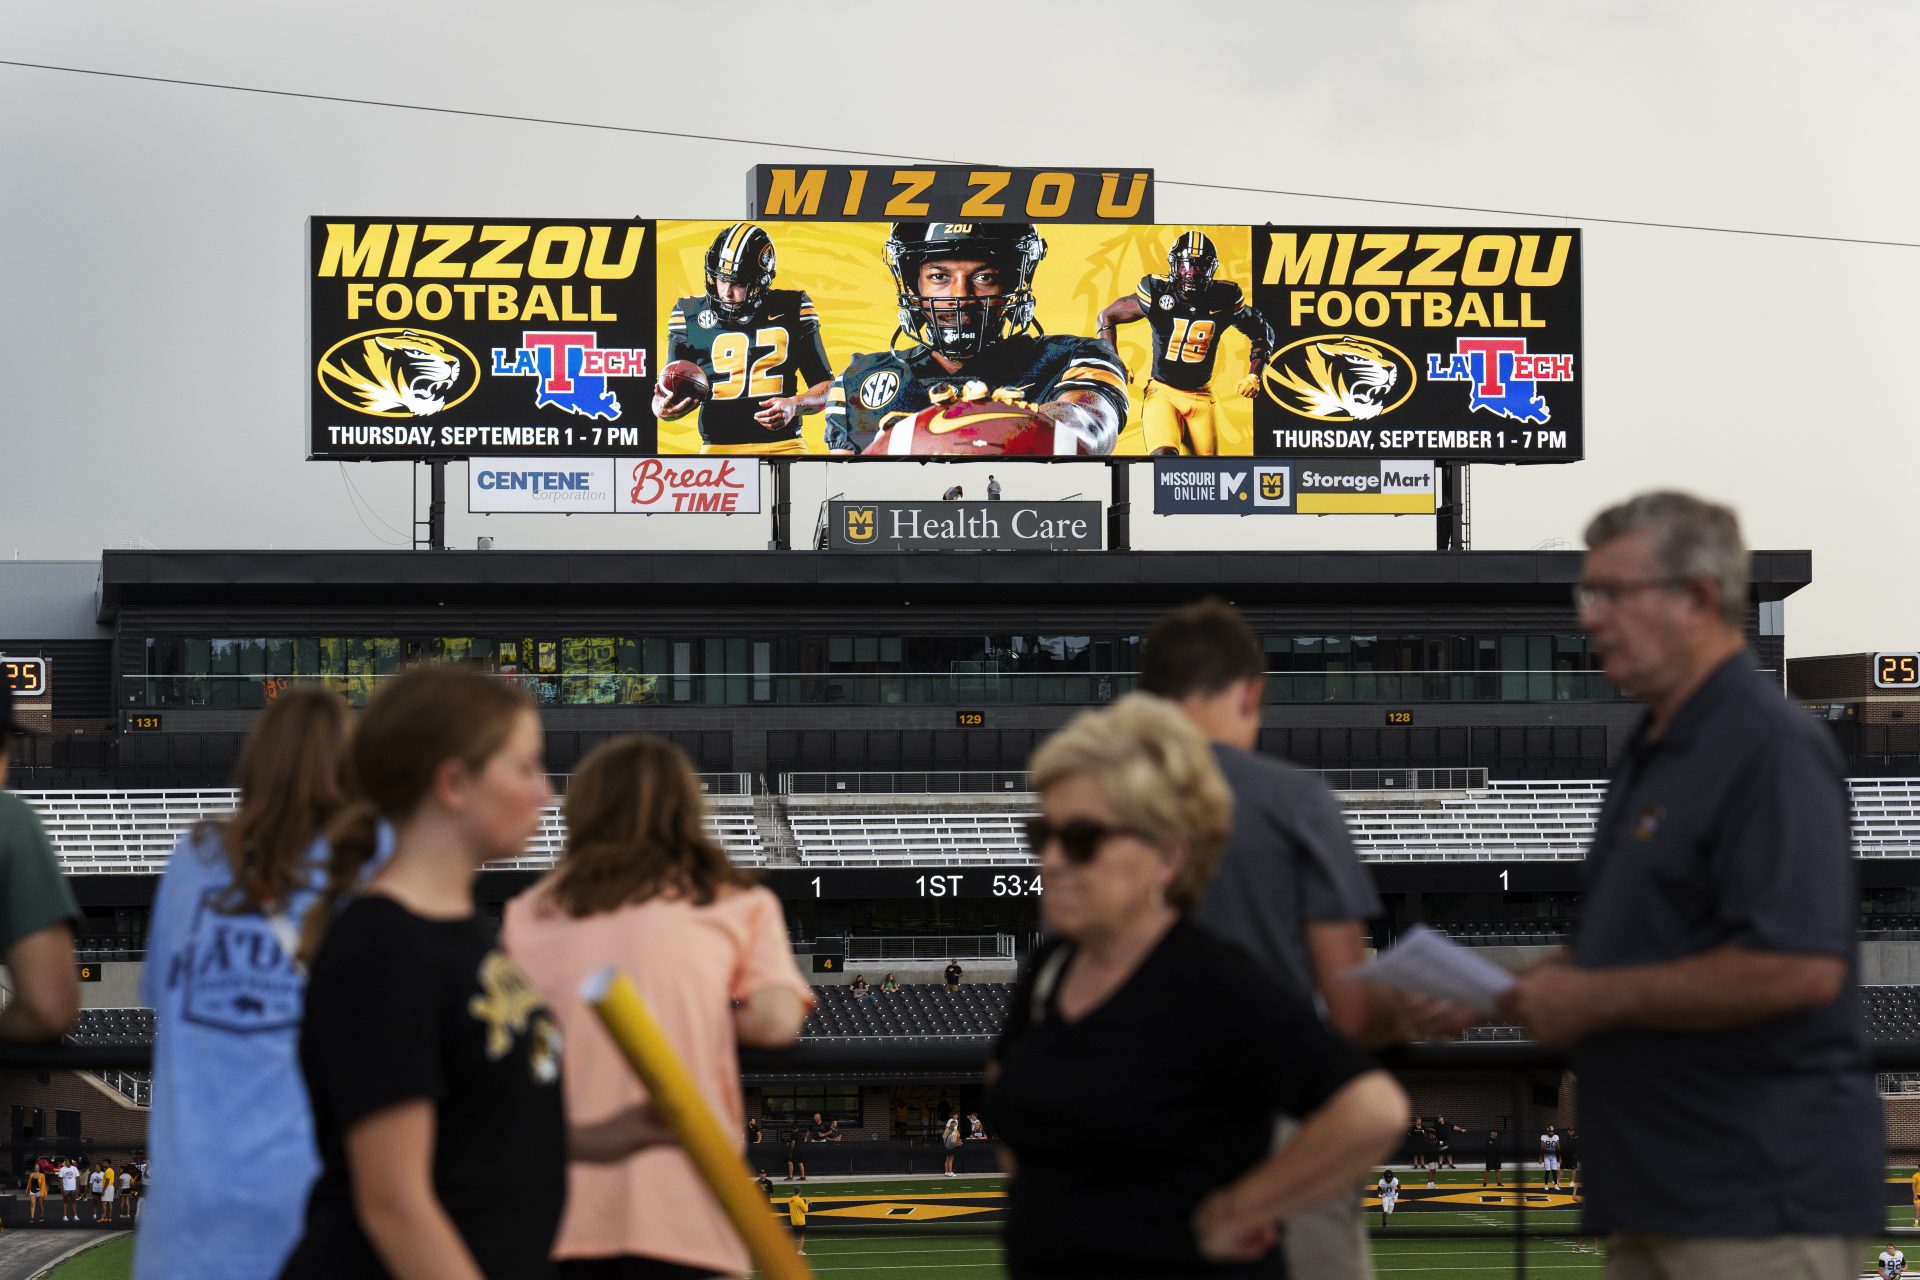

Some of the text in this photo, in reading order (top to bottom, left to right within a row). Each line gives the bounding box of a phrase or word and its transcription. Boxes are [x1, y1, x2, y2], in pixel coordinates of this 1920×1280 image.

[764, 168, 1149, 218] MIZZOU
[944, 223, 973, 234] ZOU
[318, 223, 646, 280] MIZZOU
[1262, 233, 1573, 287] MIZZOU
[347, 283, 617, 321] FOOTBALL
[1290, 291, 1546, 328] FOOTBALL
[1165, 317, 1216, 363] 18
[711, 327, 789, 401] 92
[861, 372, 898, 408] SEC
[328, 426, 435, 447] THURSDAY,
[441, 426, 559, 445] SEPTEMBER
[564, 427, 573, 445] 1
[592, 427, 602, 445] 7
[607, 427, 639, 446] PM
[1272, 430, 1375, 450] THURSDAY,
[1380, 430, 1492, 448] SEPTEMBER
[1496, 431, 1505, 448] 1
[1522, 431, 1532, 448] 7
[1538, 431, 1567, 448] PM
[477, 470, 590, 494] CENTENE
[631, 459, 745, 504] Break
[1161, 471, 1216, 486] MISSOURI
[531, 488, 607, 502] Corporation
[672, 493, 739, 512] TIME
[1174, 487, 1216, 500] ONLINE
[889, 508, 1087, 540] Health Care
[6, 664, 37, 689] 25
[1883, 658, 1914, 681] 25
[136, 717, 159, 728] 131
[959, 714, 982, 725] 129
[1388, 713, 1411, 723] 128
[811, 875, 1044, 898] 1 1ST 53:4
[1498, 870, 1509, 891] 1
[81, 967, 91, 978] 6
[823, 959, 833, 969] 4
[1887, 1259, 1902, 1270] 92
